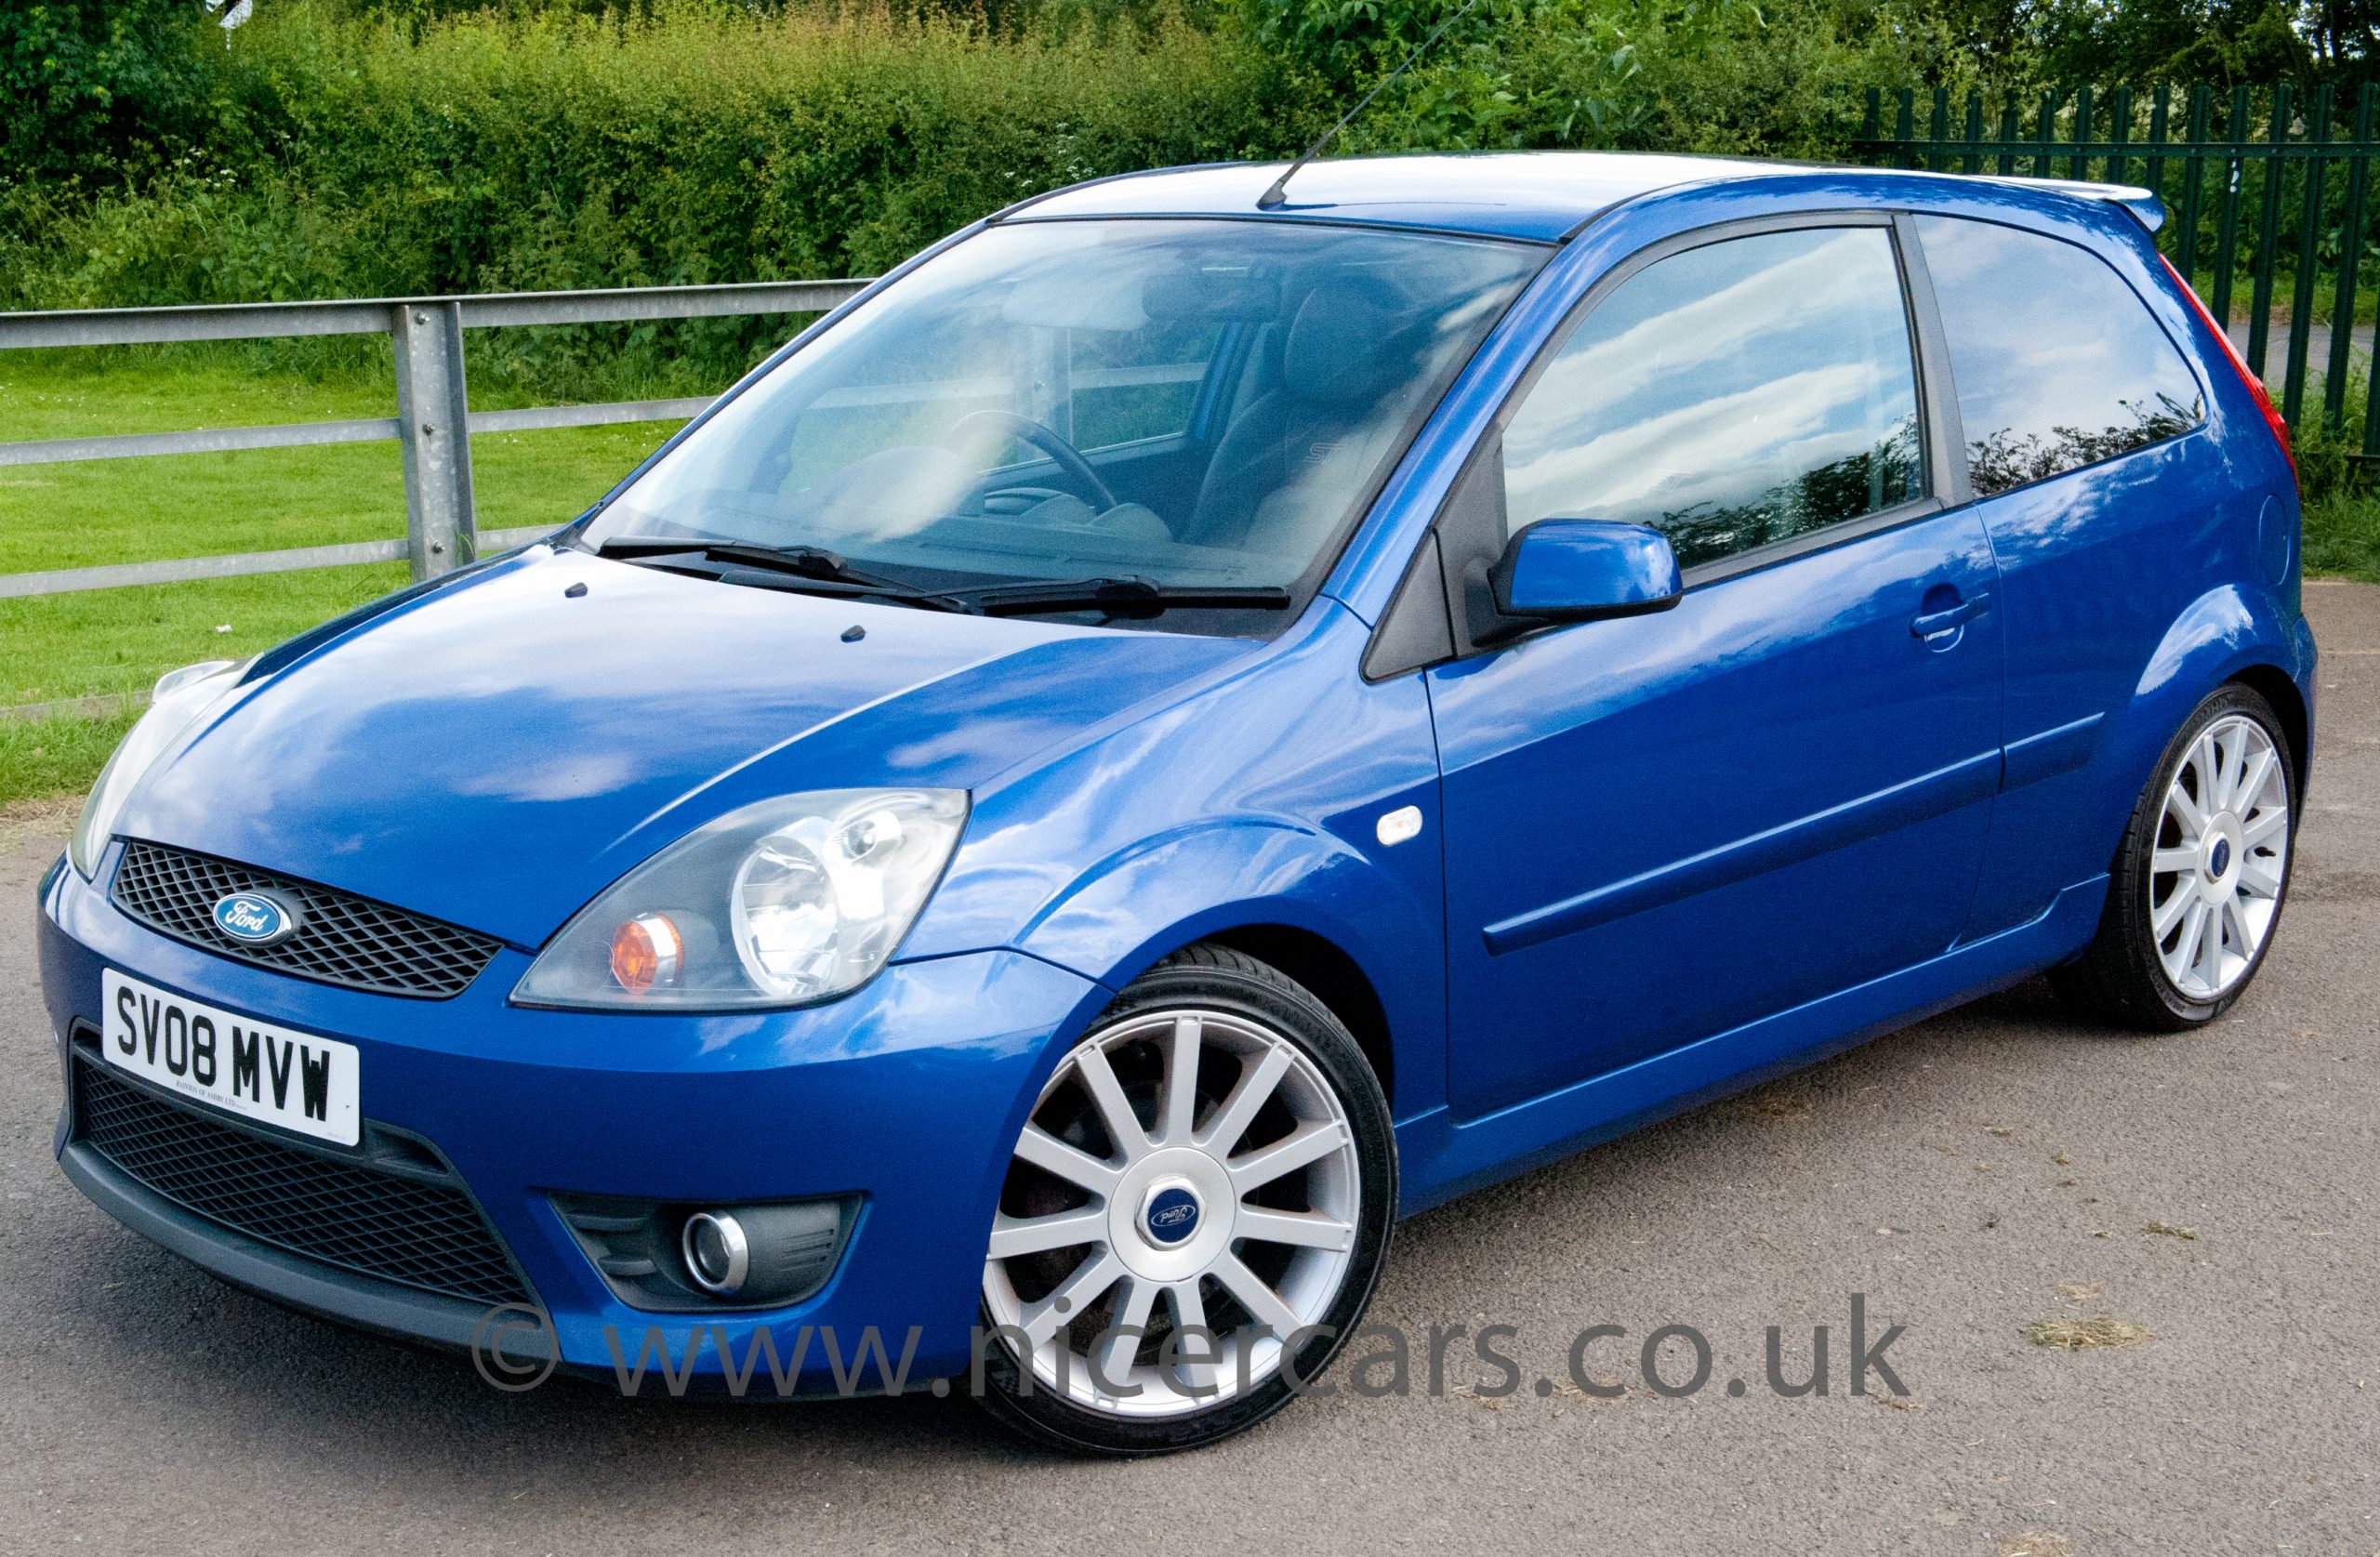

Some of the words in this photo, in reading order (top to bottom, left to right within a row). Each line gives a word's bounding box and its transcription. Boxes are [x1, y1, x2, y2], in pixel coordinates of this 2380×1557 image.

[225, 900, 269, 931] Ford
[117, 985, 217, 1088] SV08
[232, 1025, 330, 1122] MVW
[1159, 1206, 1188, 1224] Ford
